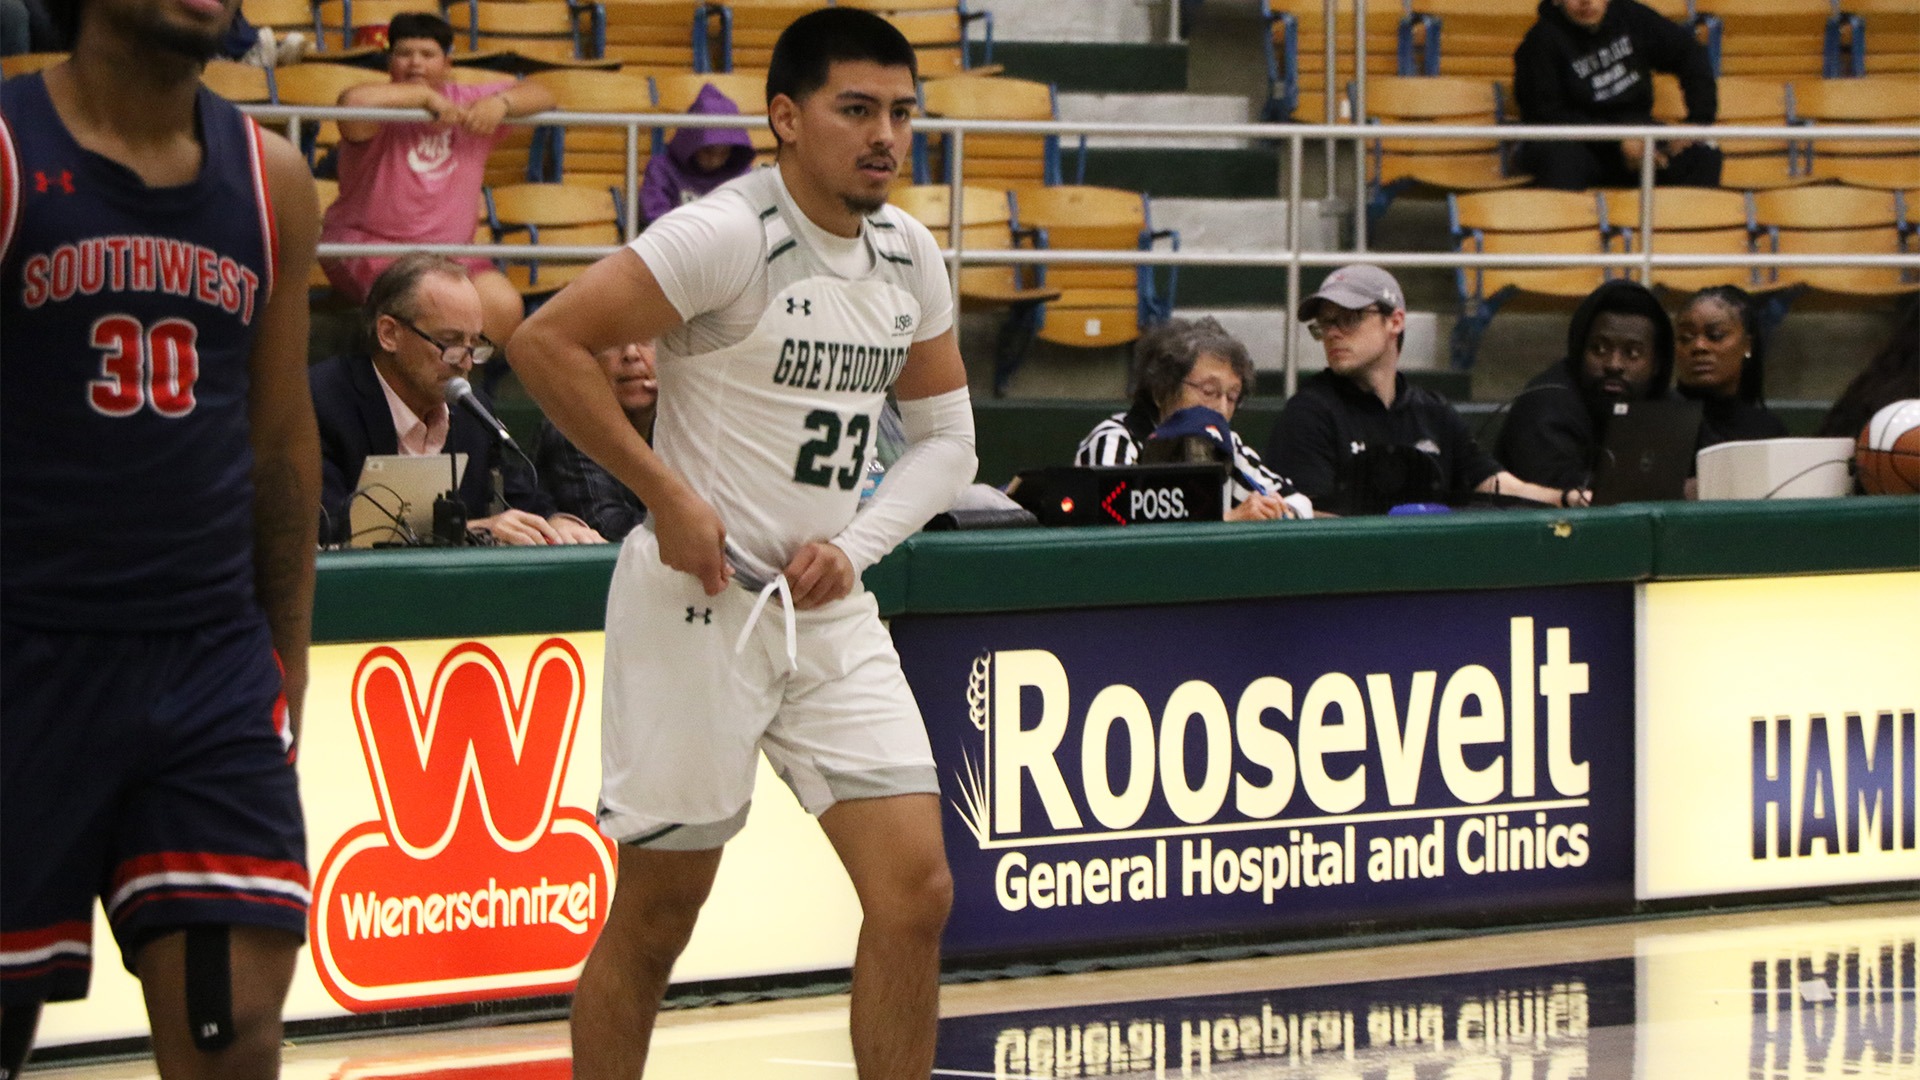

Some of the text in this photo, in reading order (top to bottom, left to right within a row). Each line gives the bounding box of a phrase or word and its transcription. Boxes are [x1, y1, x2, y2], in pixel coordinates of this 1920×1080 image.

[24, 234, 259, 326] SOUTHWEST
[88, 314, 199, 418] 30
[773, 337, 910, 394] GREYHOUND
[793, 409, 871, 490] 23
[1130, 487, 1189, 520] POSS.
[356, 647, 581, 859] W
[995, 616, 1589, 834] Roosevelt
[340, 872, 597, 941] Wienerschnitzel
[995, 811, 1590, 912] General Hospital and Clinics
